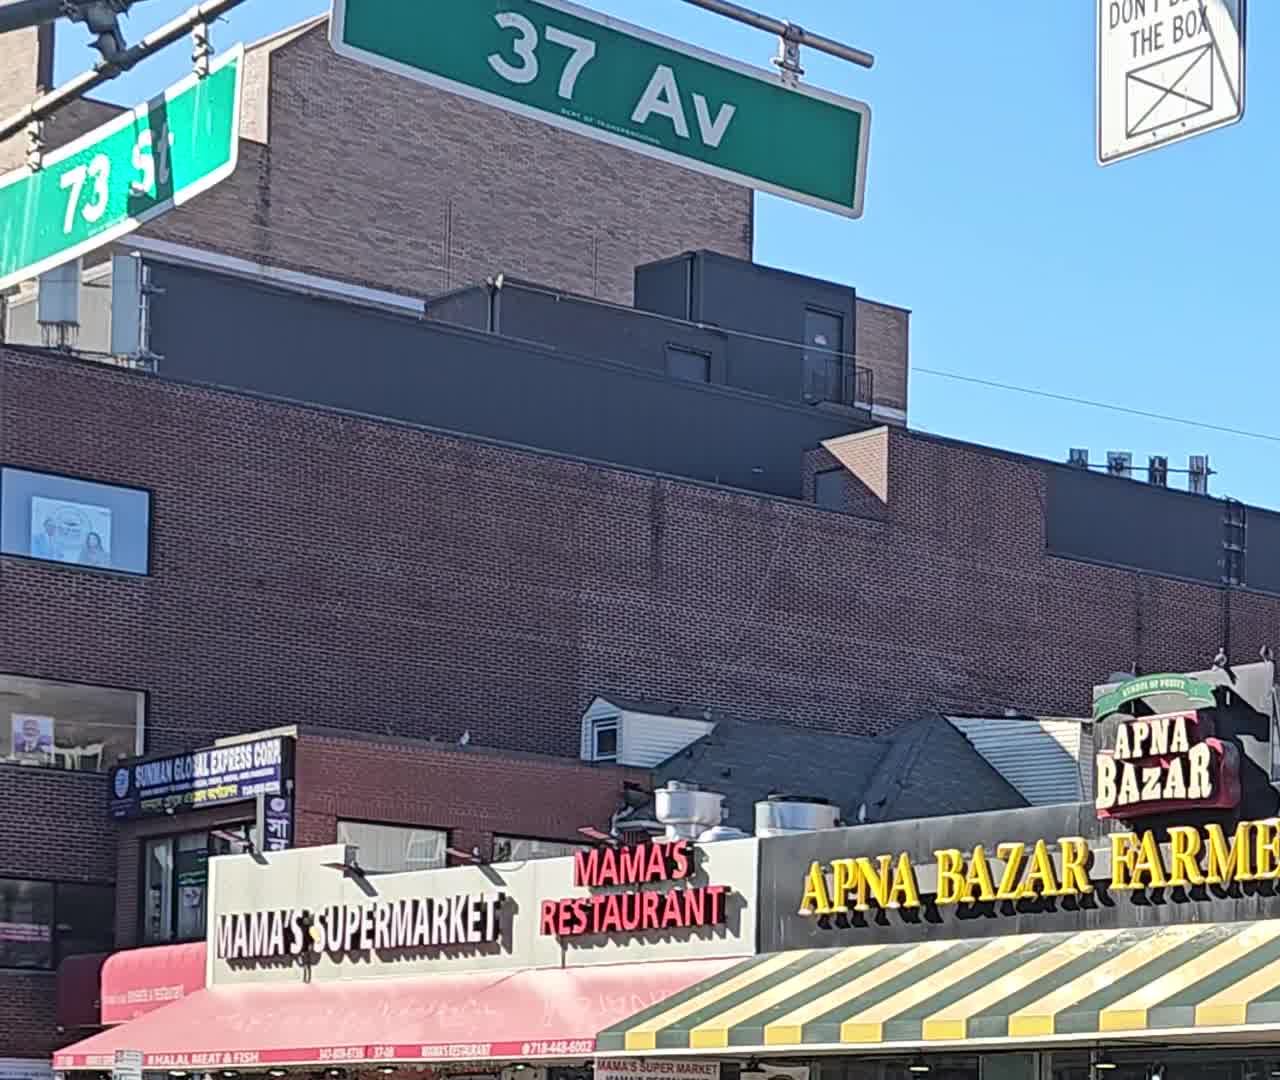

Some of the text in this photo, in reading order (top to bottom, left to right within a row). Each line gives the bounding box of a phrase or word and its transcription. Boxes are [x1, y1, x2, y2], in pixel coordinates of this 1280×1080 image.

[1130, 5, 1208, 58] THE BOX
[487, 11, 737, 148] 37 Av
[60, 128, 175, 234] 73 St
[1114, 716, 1190, 760] APNA
[1096, 742, 1213, 809] BAZAR
[573, 839, 690, 887] MAMA'S
[798, 851, 921, 917] APNA
[934, 836, 1094, 906] BAZAR
[216, 891, 501, 958] MAMA'S SUPERMARKET
[540, 885, 726, 936] RESTAURANT
[598, 1060, 719, 1076] MAMA'S SUPER MARKET
